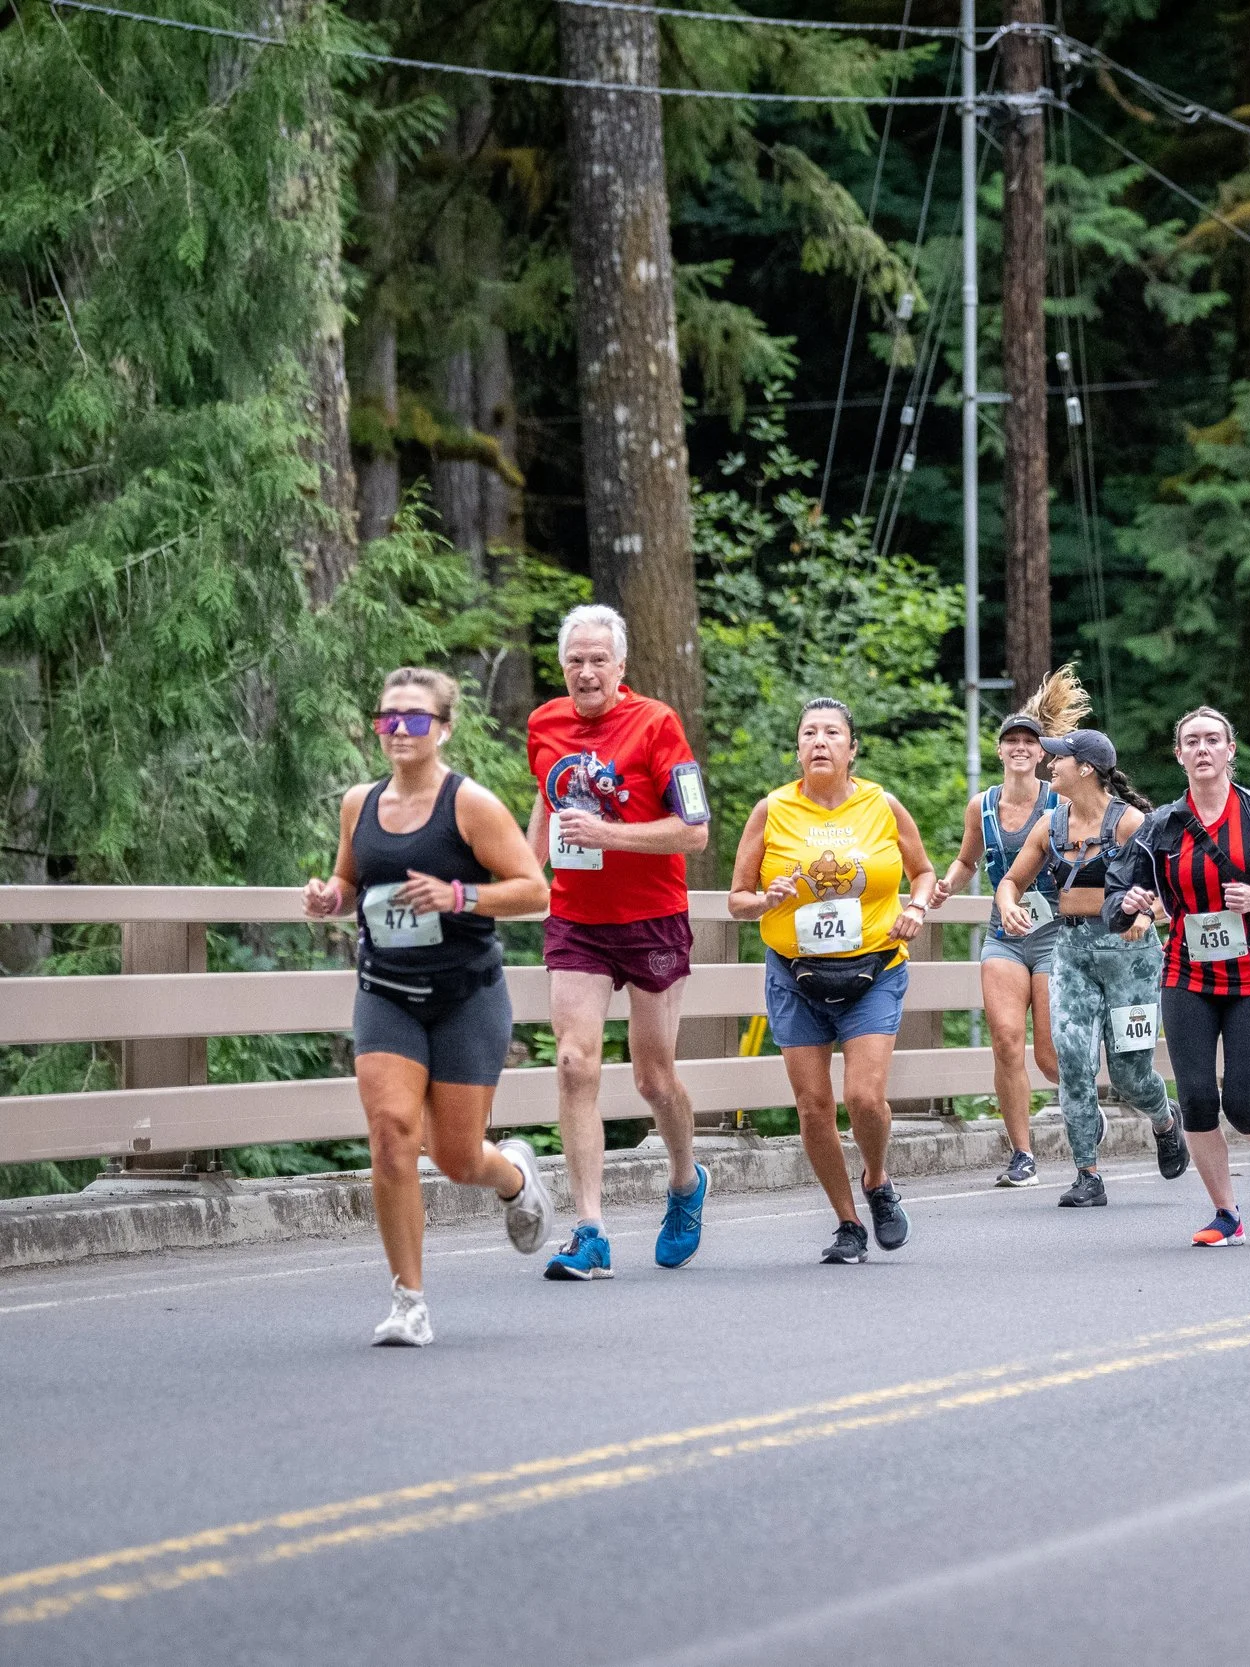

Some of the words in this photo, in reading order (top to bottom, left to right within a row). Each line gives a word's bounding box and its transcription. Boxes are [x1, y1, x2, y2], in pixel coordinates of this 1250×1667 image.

[385, 908, 418, 929] 471
[813, 919, 846, 939] 424
[1200, 930, 1230, 948] 436
[1126, 1021, 1152, 1038] 404
